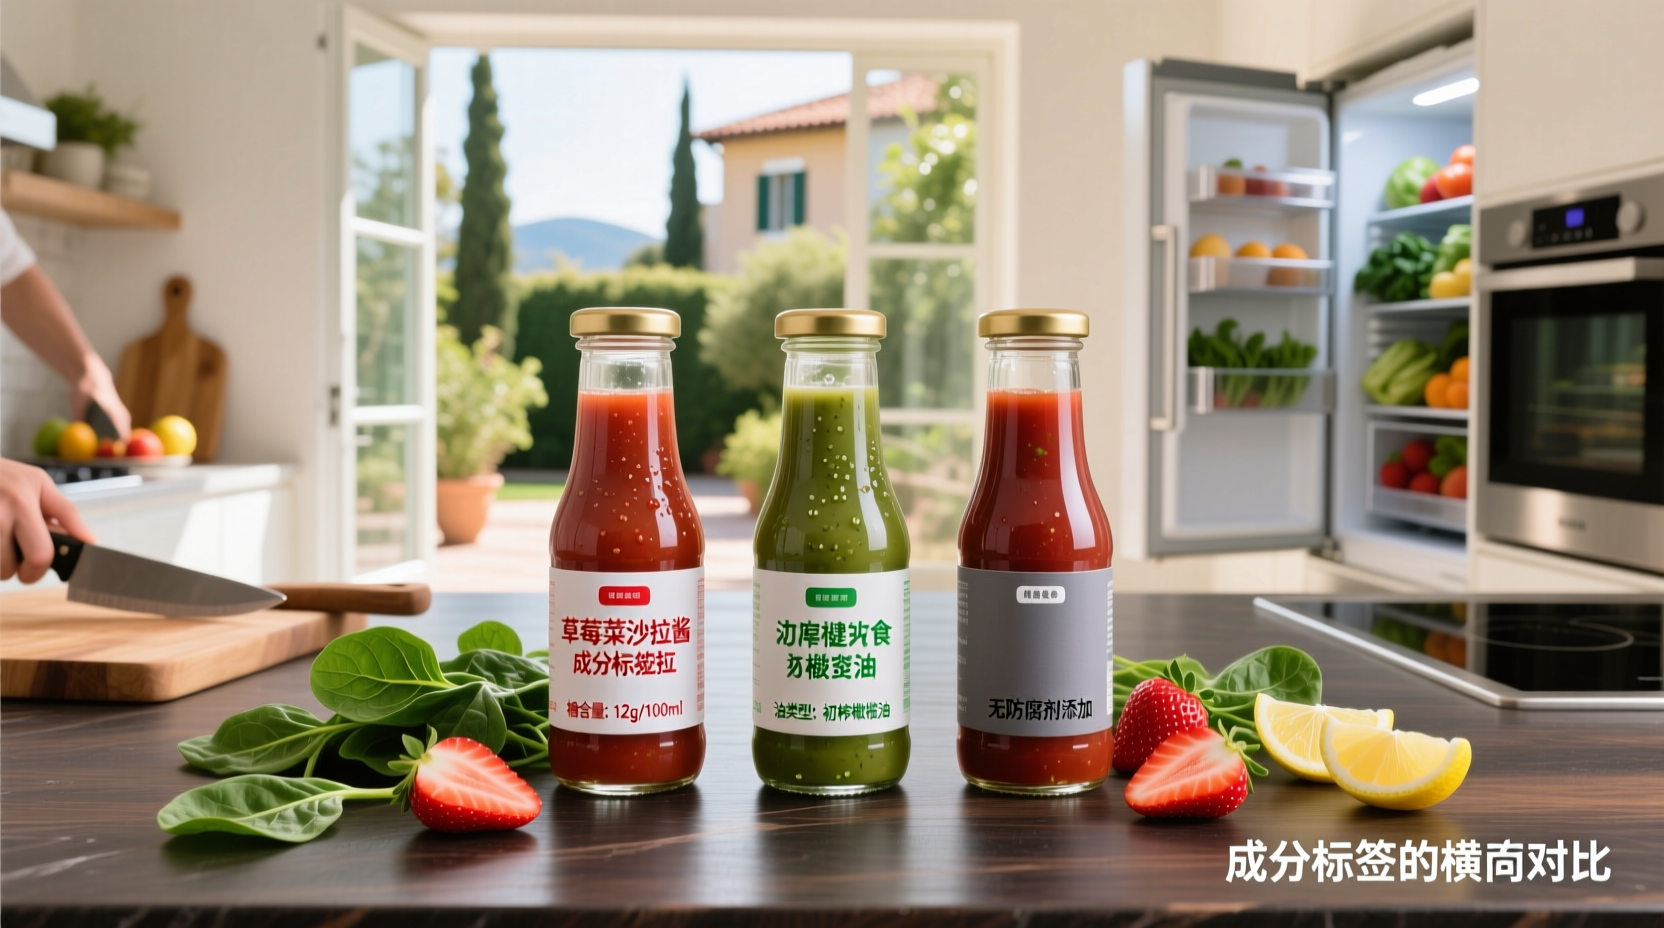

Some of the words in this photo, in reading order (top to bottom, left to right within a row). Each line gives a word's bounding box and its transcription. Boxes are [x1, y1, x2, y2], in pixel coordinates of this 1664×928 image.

[561, 616, 691, 646] 草莓菜沙拉酱
[613, 700, 683, 723] 12g/100ml
[988, 698, 1093, 721] 无防腐剂添加
